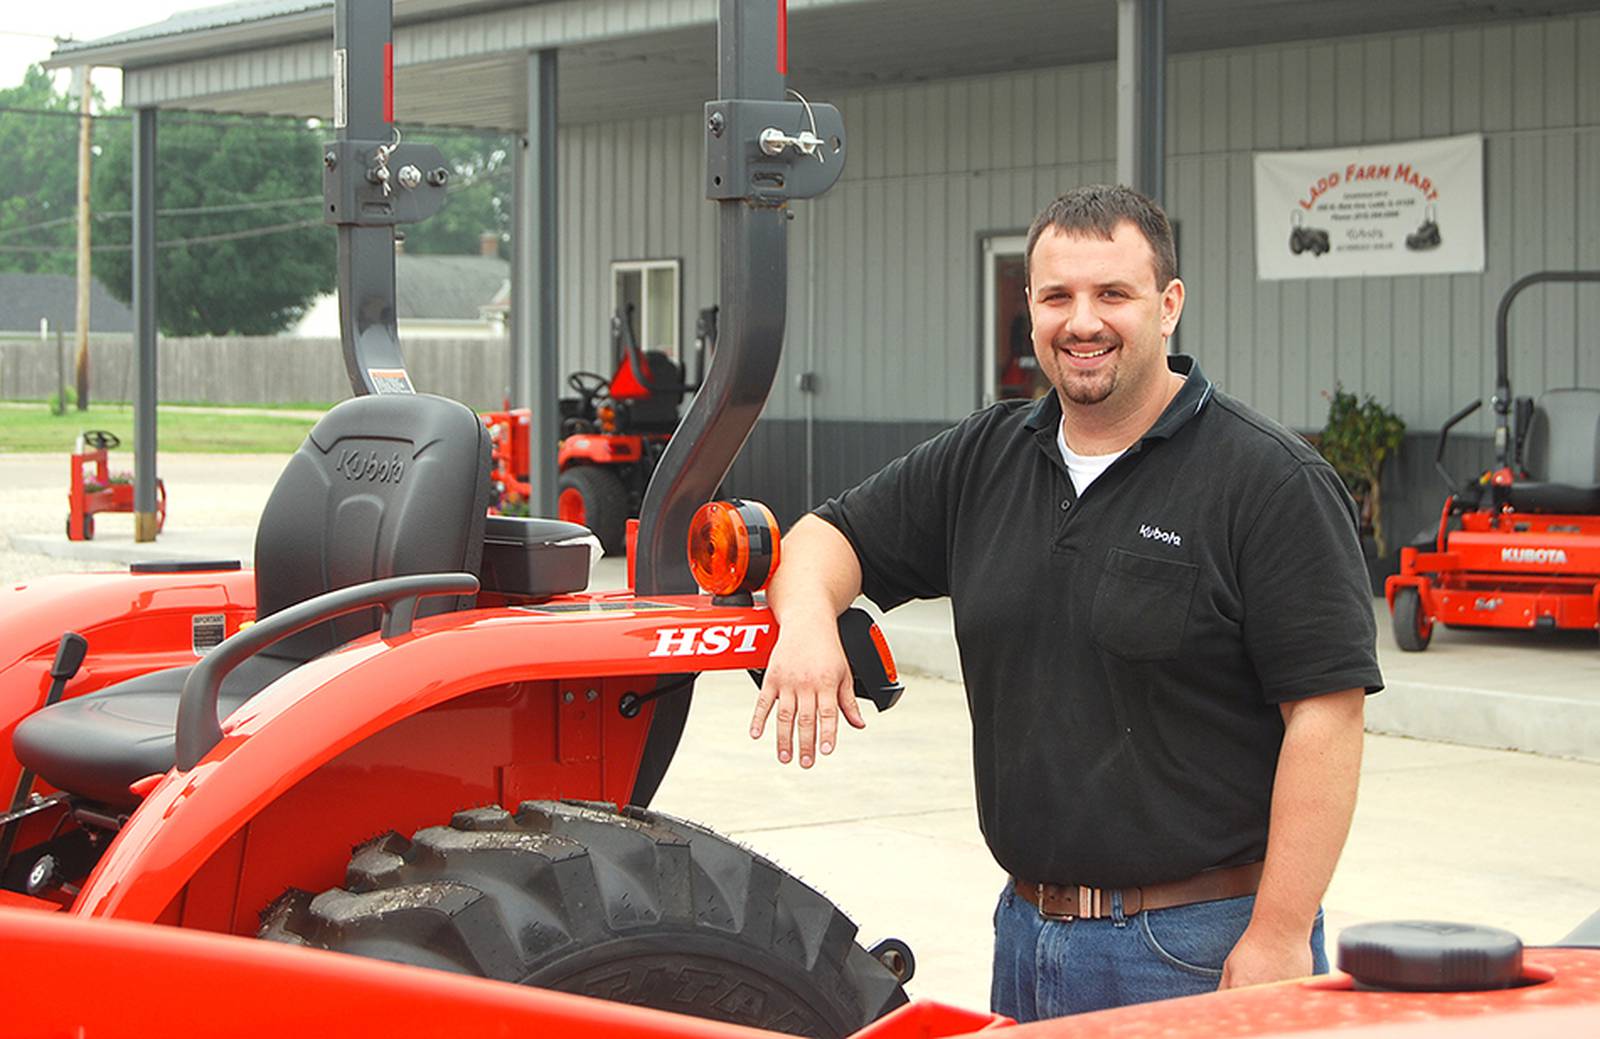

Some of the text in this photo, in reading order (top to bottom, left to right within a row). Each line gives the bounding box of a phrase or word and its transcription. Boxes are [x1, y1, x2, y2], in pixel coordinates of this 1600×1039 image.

[1344, 163, 1391, 183] FARM
[1394, 163, 1438, 201] MART
[336, 449, 404, 484] Kubota
[1139, 524, 1182, 547] Kubota
[1501, 547, 1567, 563] KUBOTA
[648, 624, 770, 657] HST
